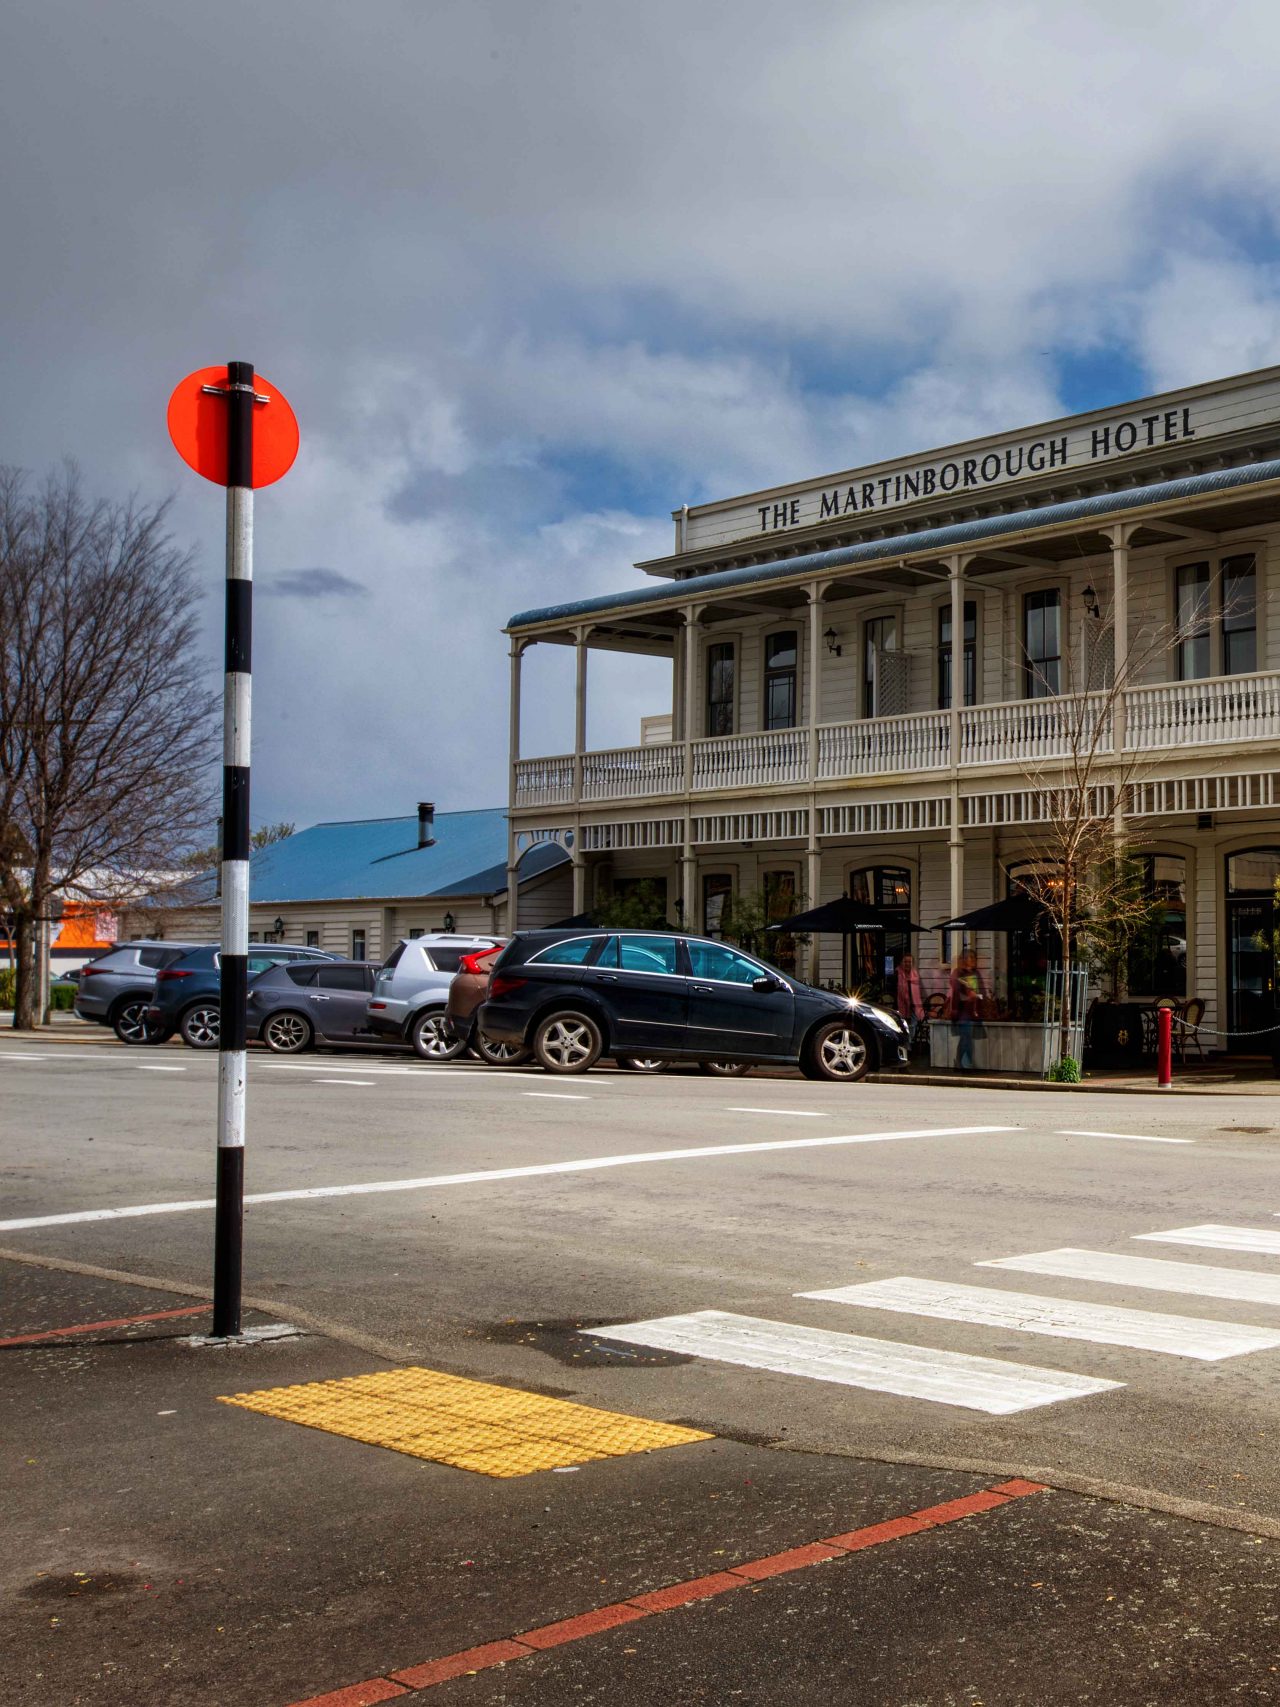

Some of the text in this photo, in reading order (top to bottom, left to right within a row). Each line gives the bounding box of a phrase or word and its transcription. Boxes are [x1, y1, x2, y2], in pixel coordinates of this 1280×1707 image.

[758, 407, 1195, 531] THE MARTINBOROUGH HOTEL
